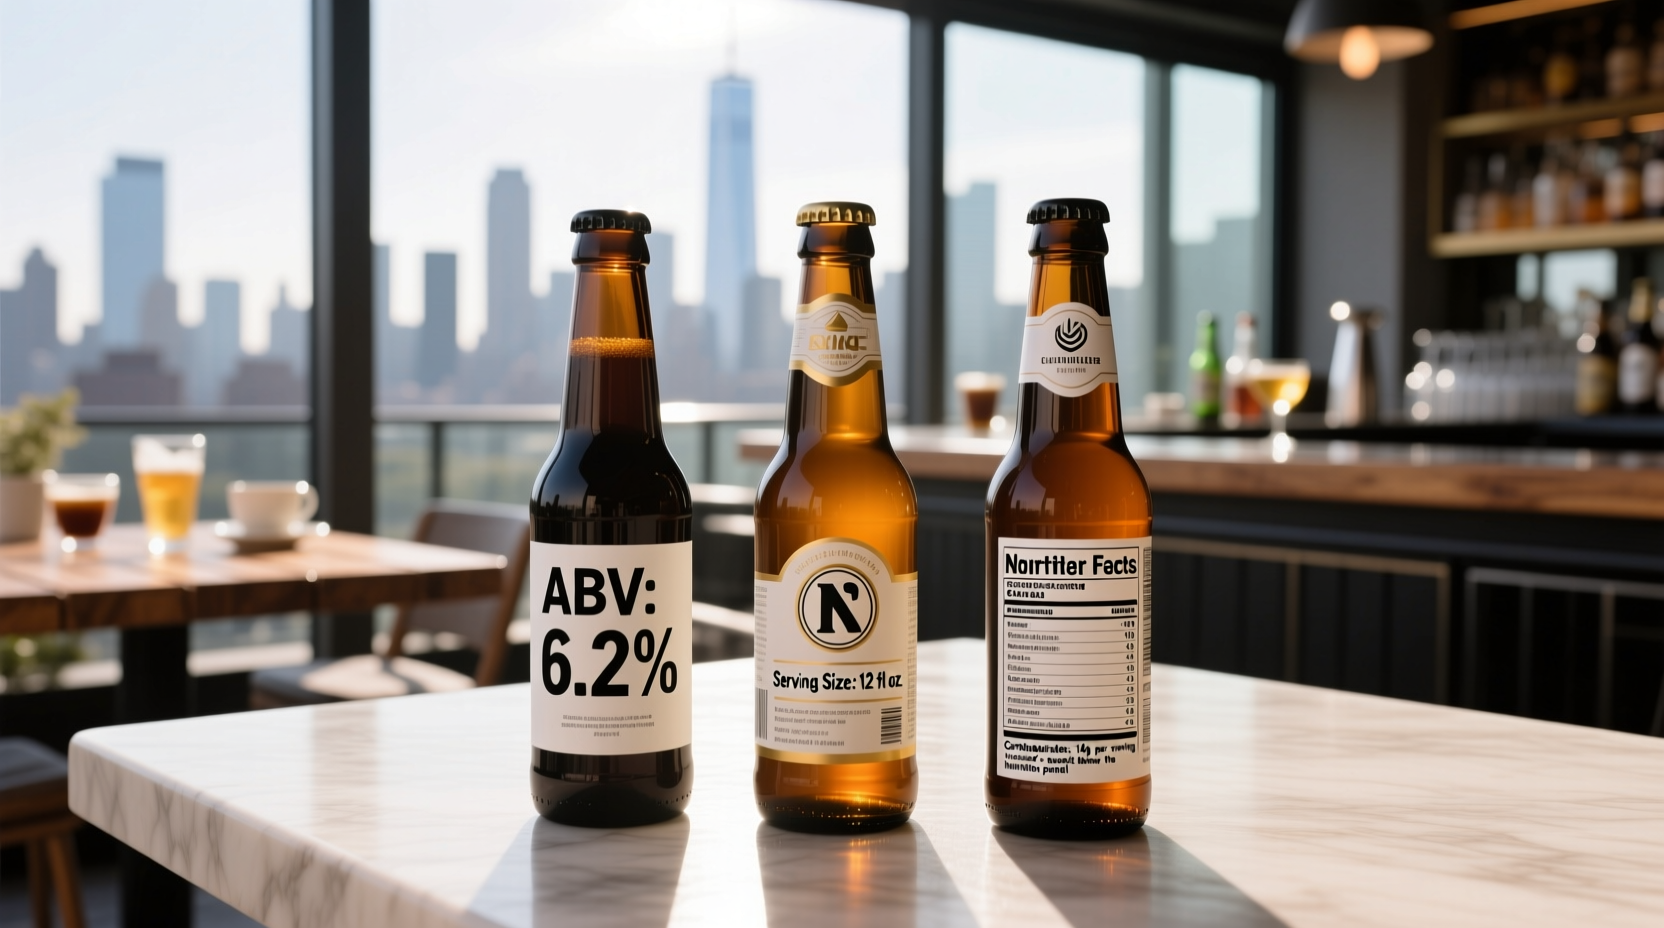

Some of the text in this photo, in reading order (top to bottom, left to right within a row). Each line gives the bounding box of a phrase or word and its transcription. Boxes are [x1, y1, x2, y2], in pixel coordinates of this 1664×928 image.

[542, 567, 655, 615] ABV:
[542, 627, 678, 697] 6.2%
[773, 670, 818, 693] Serving
[822, 672, 857, 690] Size:
[860, 671, 874, 690] 12
[876, 671, 886, 689] fl
